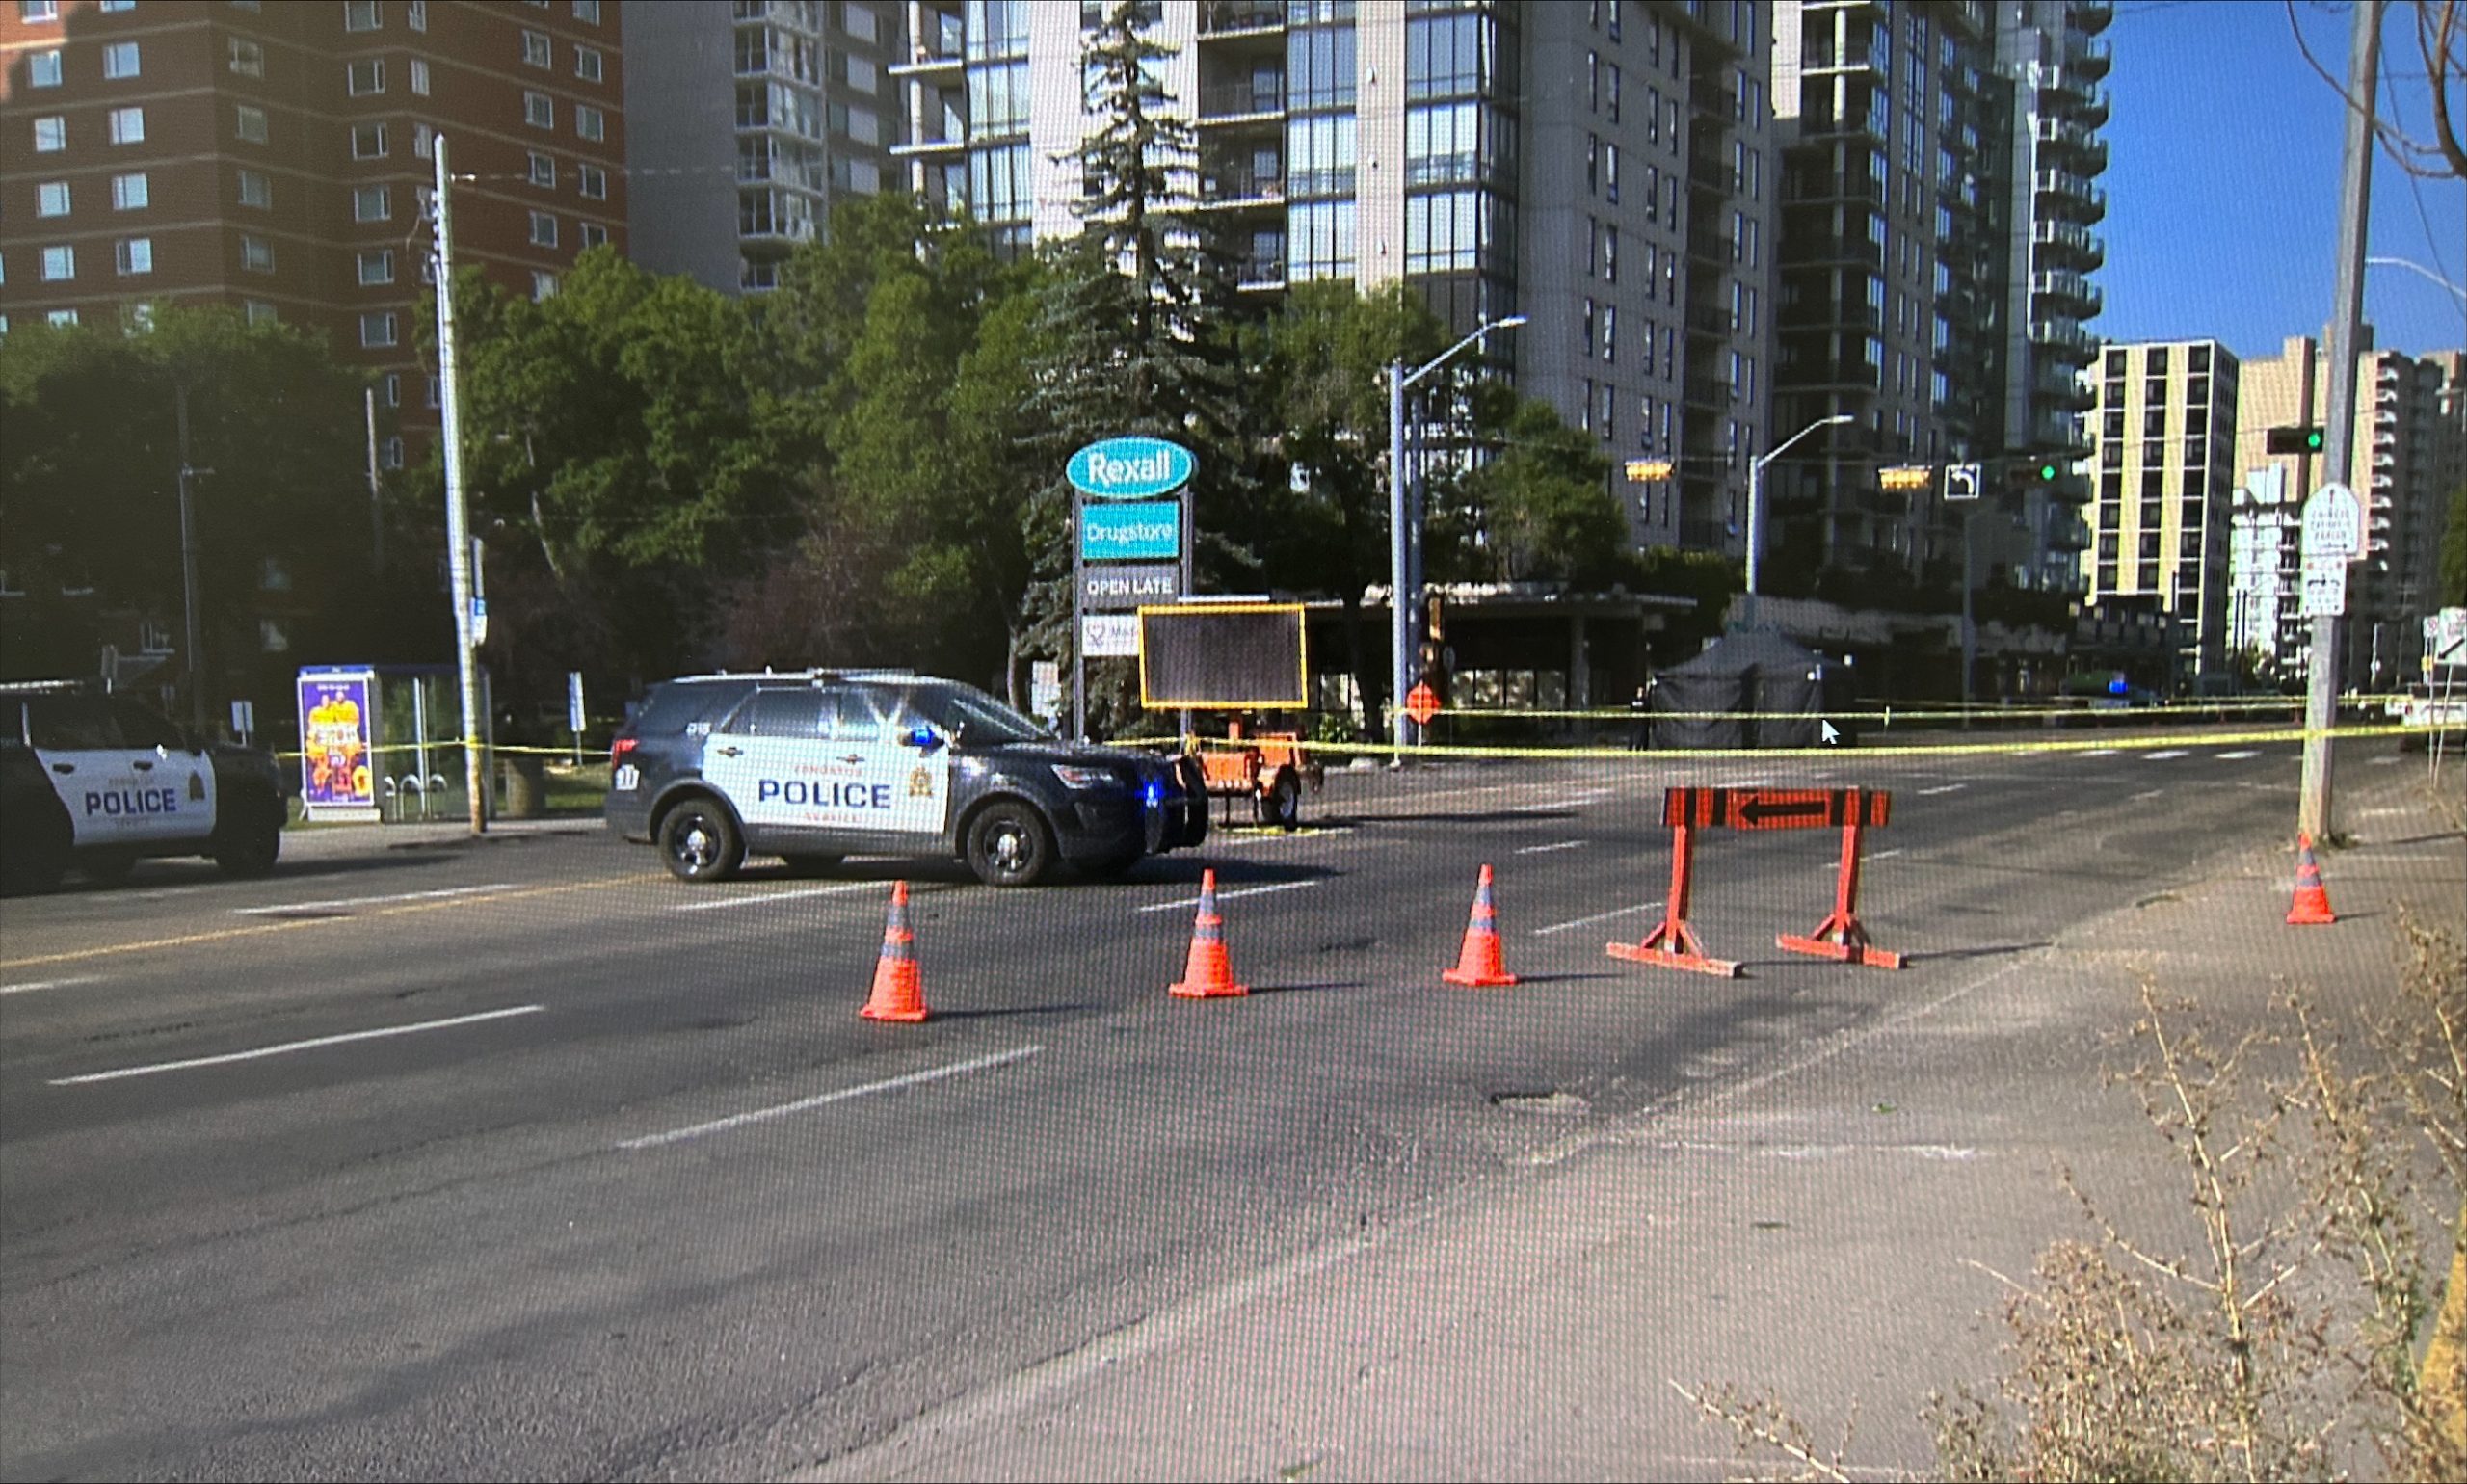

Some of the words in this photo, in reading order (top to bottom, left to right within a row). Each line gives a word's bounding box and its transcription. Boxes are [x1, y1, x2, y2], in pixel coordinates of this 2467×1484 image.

[1087, 450, 1171, 487] Rexall
[1086, 523, 1173, 545] Drugstore
[1086, 579, 1132, 596] OPEN
[1133, 578, 1173, 595] LATE
[85, 788, 177, 816] POLICE
[758, 779, 891, 809] POLICE
